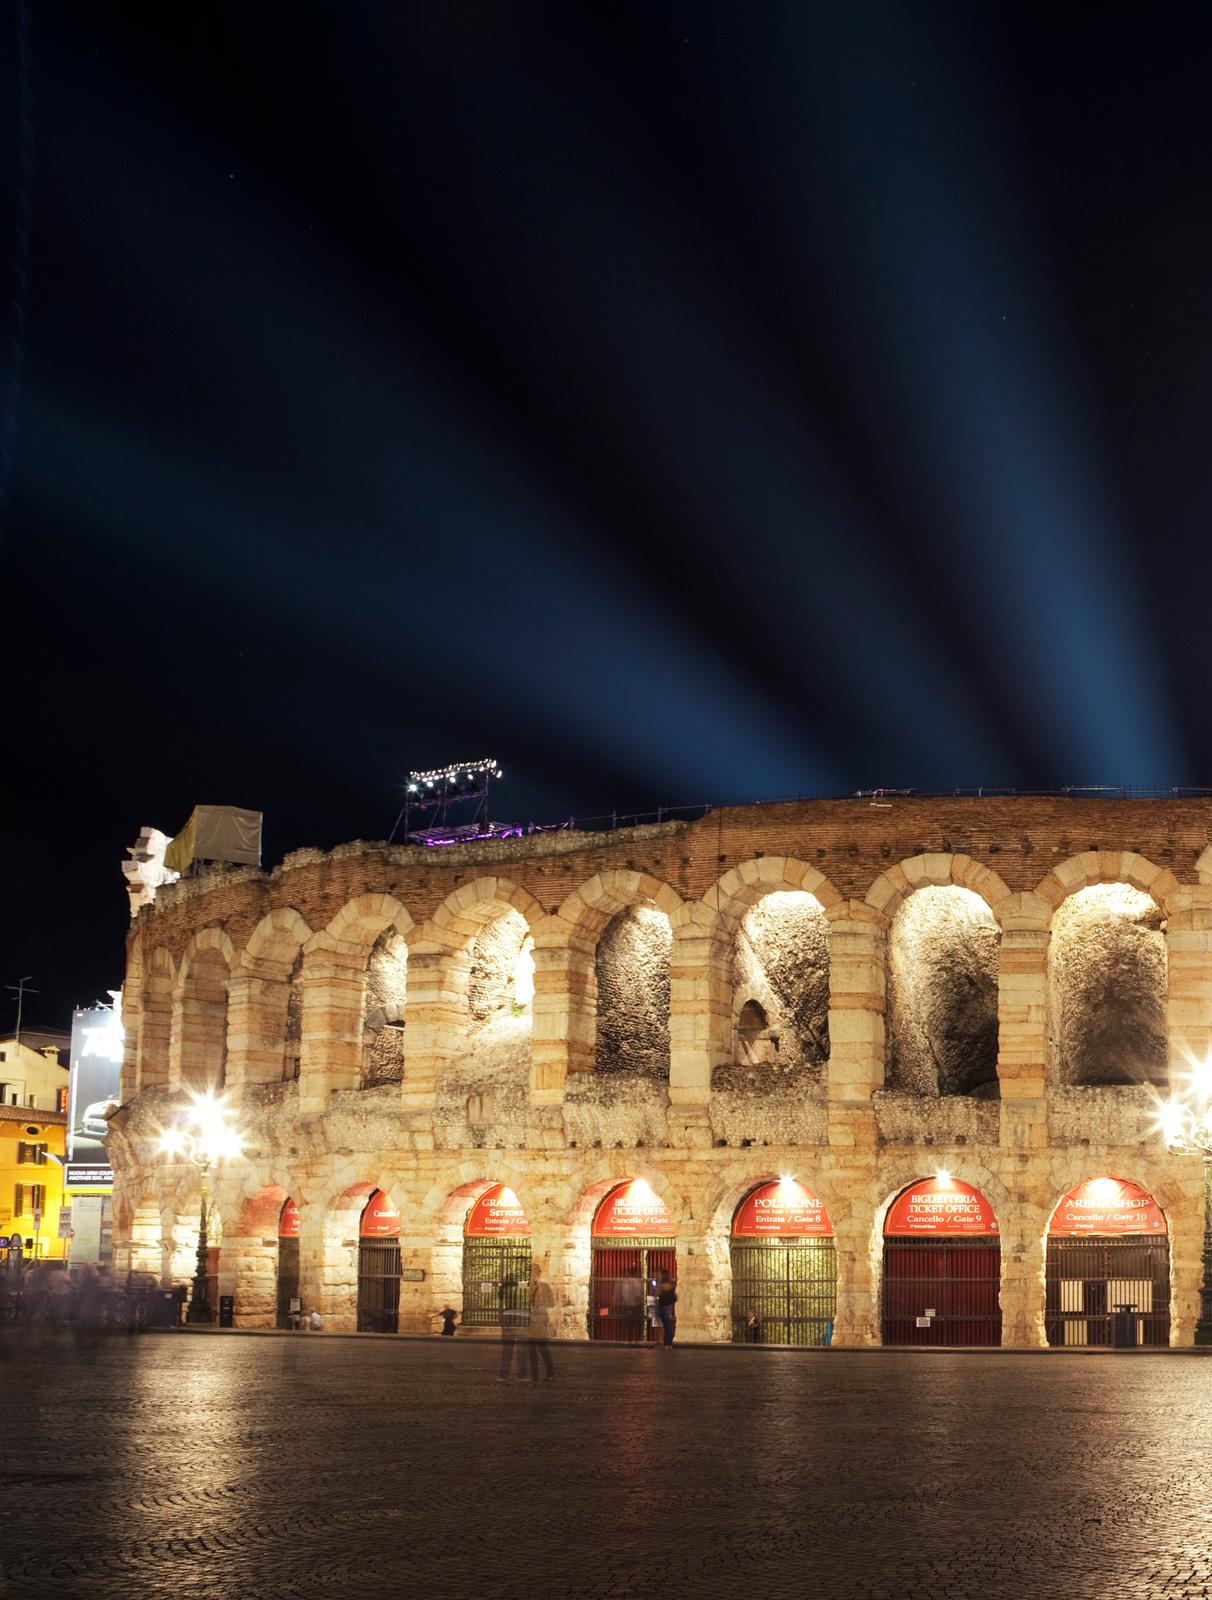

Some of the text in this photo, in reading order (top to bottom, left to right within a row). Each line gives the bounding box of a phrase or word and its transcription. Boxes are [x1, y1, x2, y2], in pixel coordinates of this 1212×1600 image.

[911, 1194, 978, 1204] BIGLIETTERIA
[909, 1204, 981, 1214] TICKET OFFICE
[610, 1216, 643, 1224] Cancello
[650, 1216, 669, 1224] Gate
[755, 1215, 785, 1223] Entrata
[793, 1215, 814, 1223] Gate
[815, 1215, 822, 1223] 8
[906, 1215, 944, 1223] Cancello
[953, 1215, 974, 1223] Gate
[975, 1215, 982, 1223] 9
[1065, 1213, 1104, 1221] Cancello
[1112, 1213, 1134, 1221] Gate
[1136, 1213, 1148, 1221] 10
